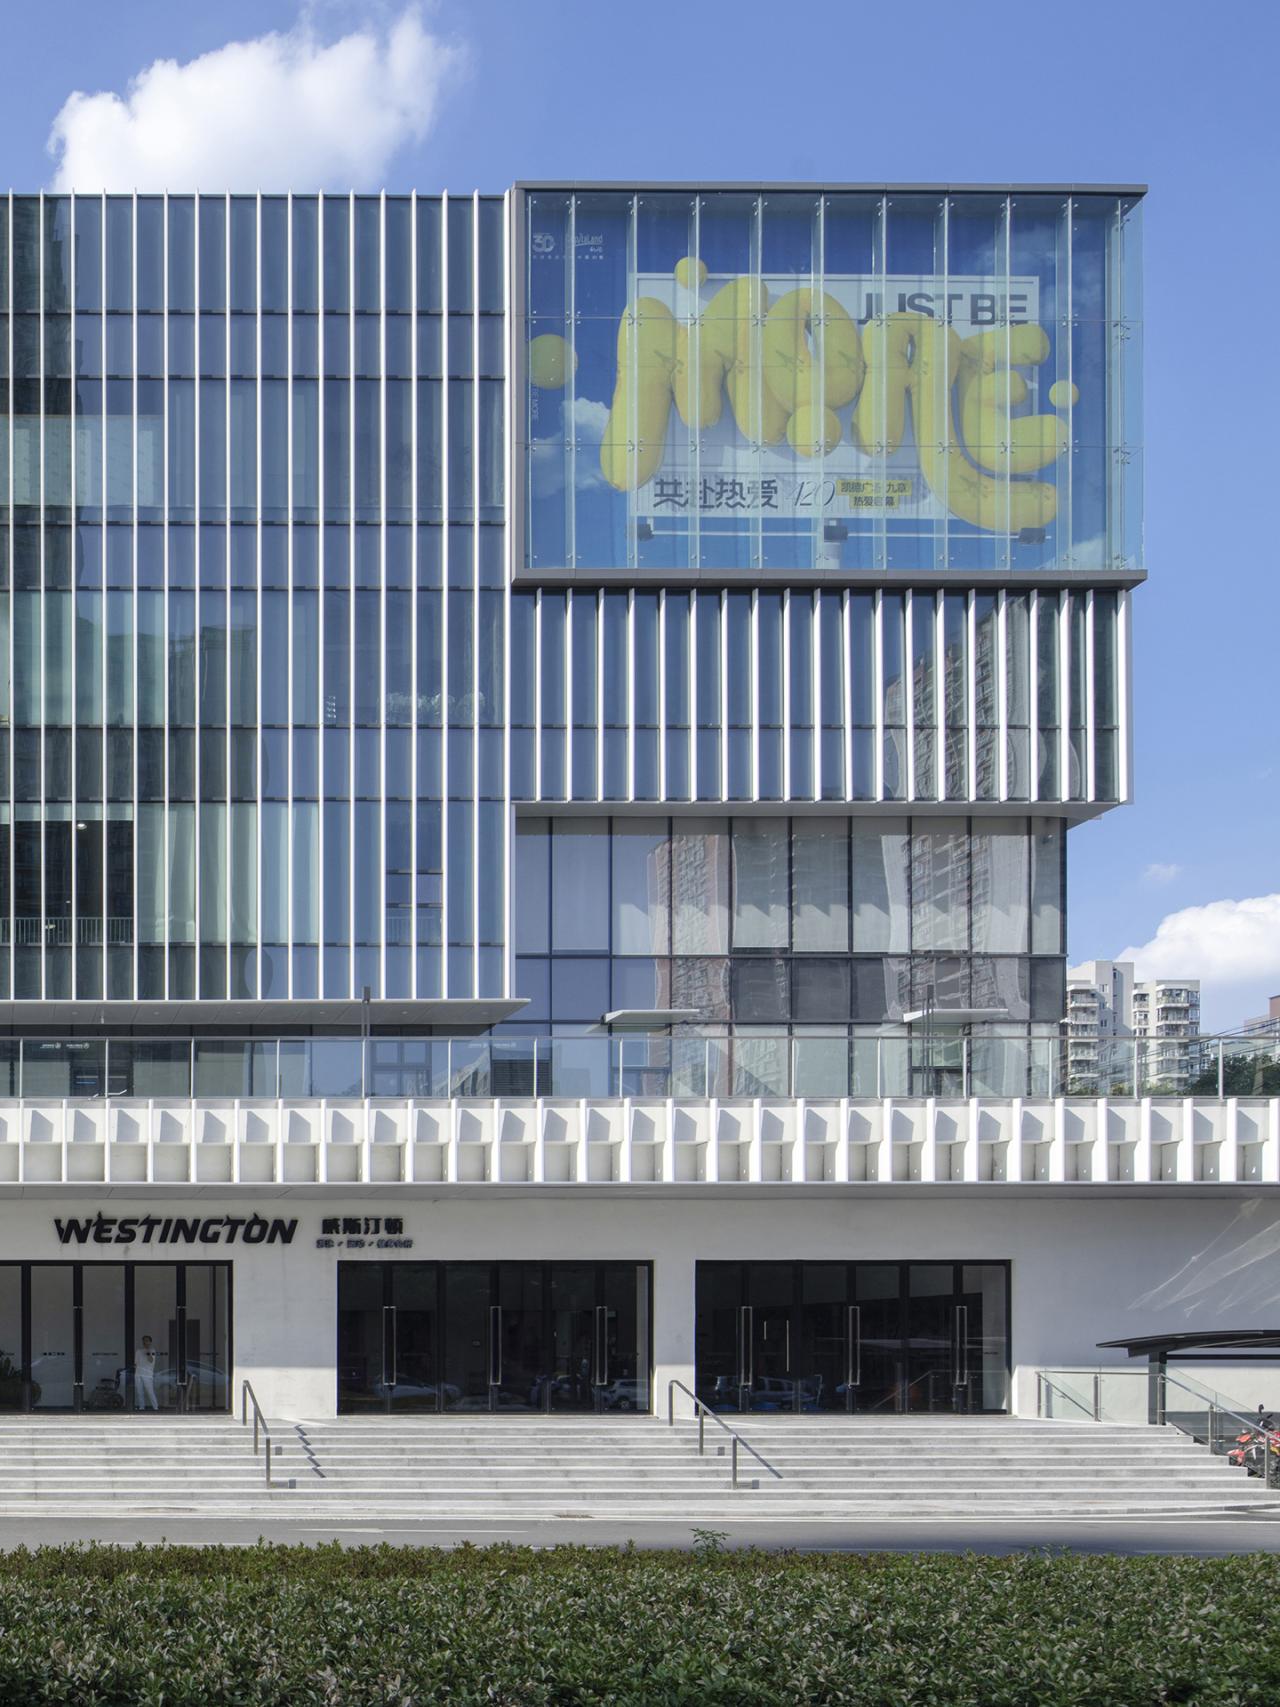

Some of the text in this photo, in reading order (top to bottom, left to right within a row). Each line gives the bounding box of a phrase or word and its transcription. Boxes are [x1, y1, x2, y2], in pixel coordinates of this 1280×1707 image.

[857, 293, 1029, 325] JUST BE
[54, 1211, 299, 1244] WESTINGTON
